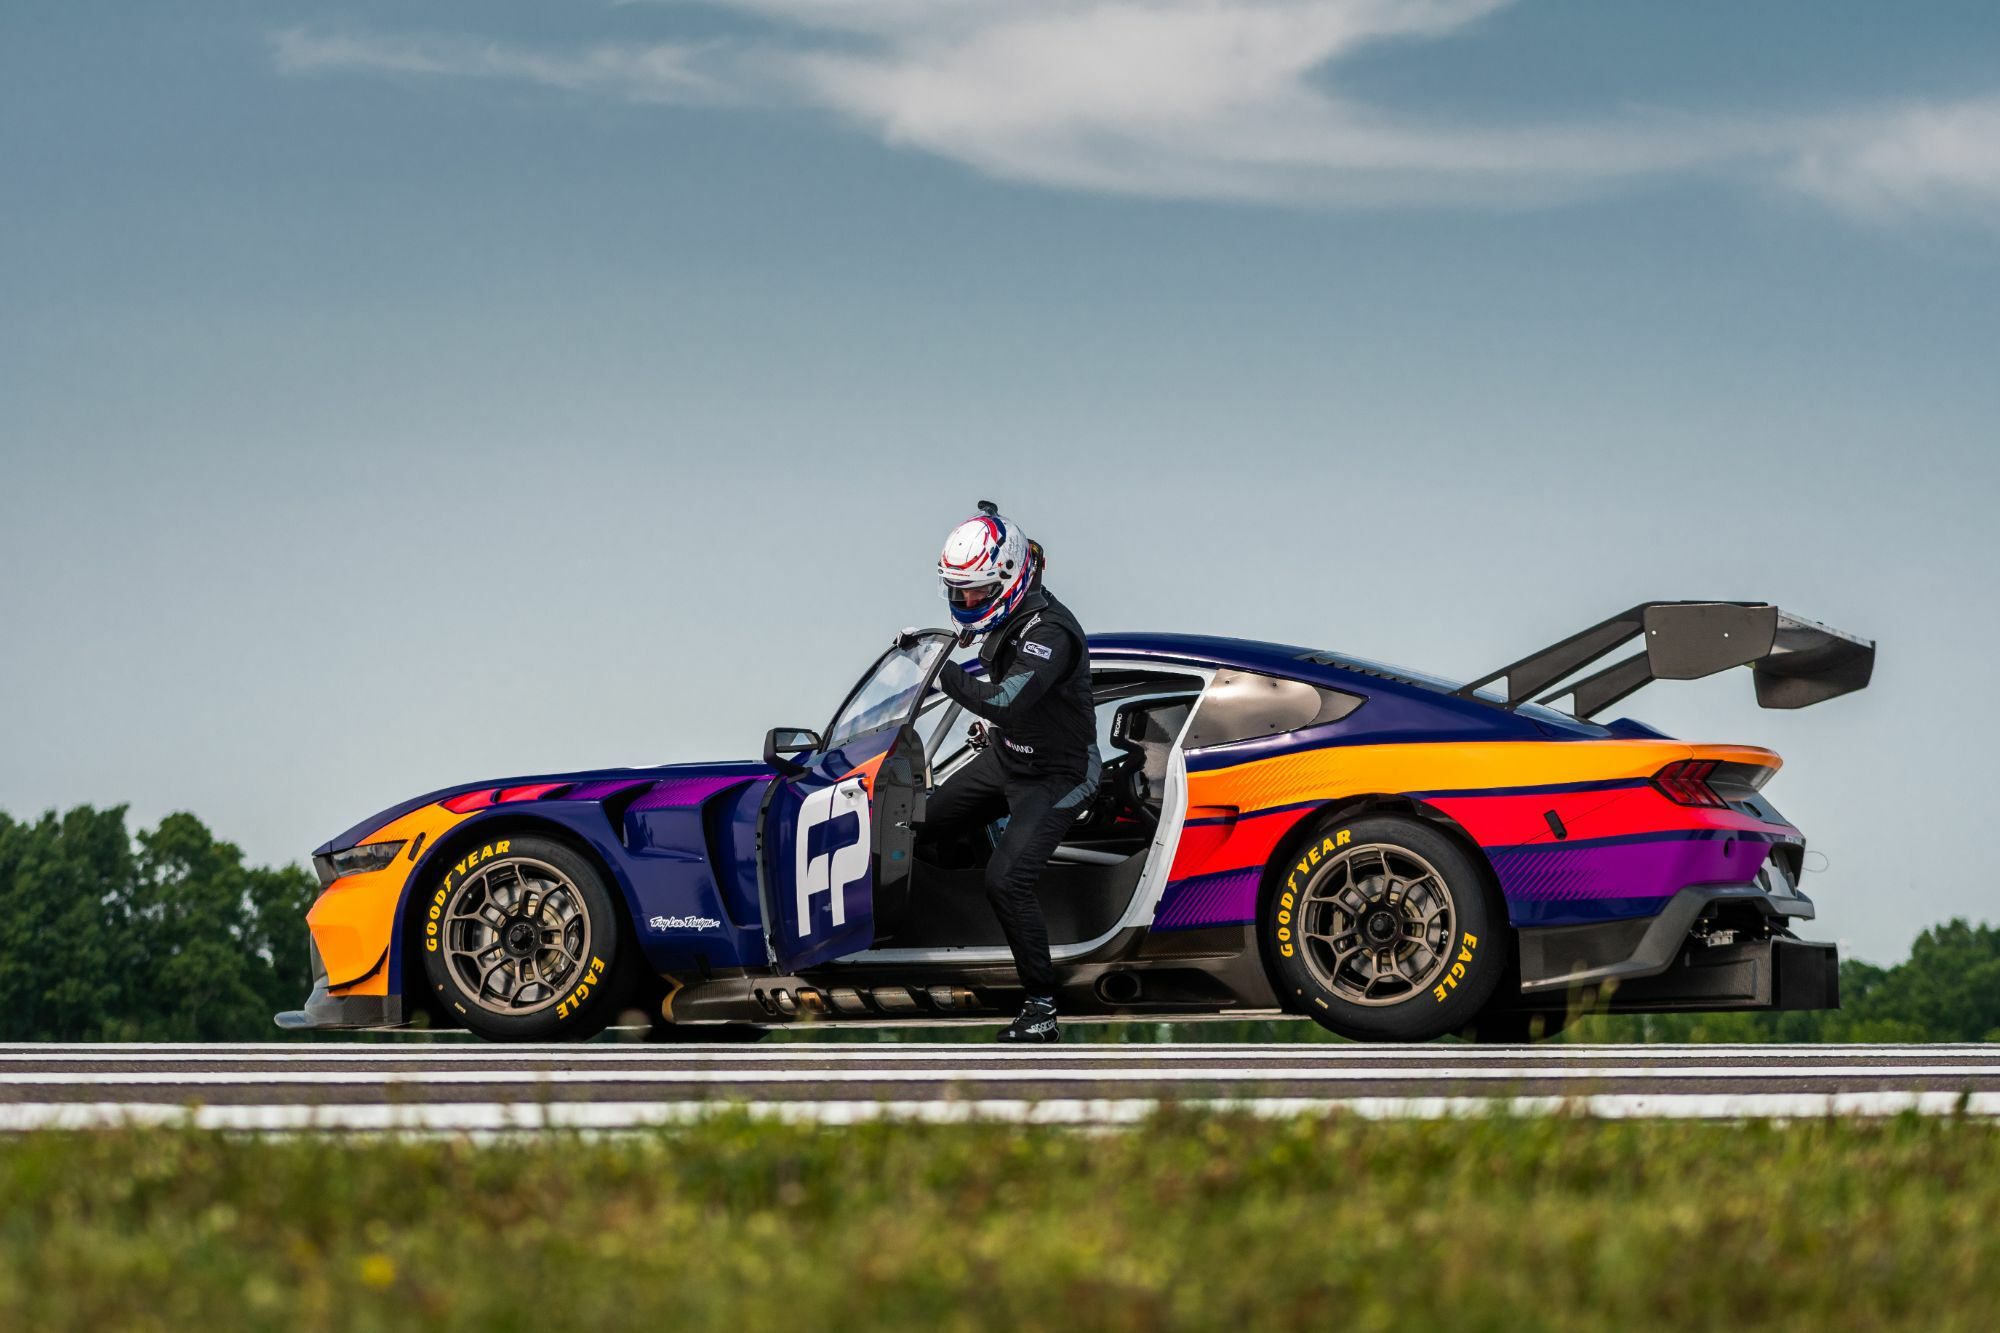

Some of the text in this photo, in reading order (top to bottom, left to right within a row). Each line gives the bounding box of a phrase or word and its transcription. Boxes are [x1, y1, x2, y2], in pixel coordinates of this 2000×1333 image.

[1113, 713, 1123, 737] RECARO
[650, 916, 720, 931] Troy Lee Designs
[556, 956, 605, 1020] EAGLE
[1433, 931, 1478, 1002] EAGLE
